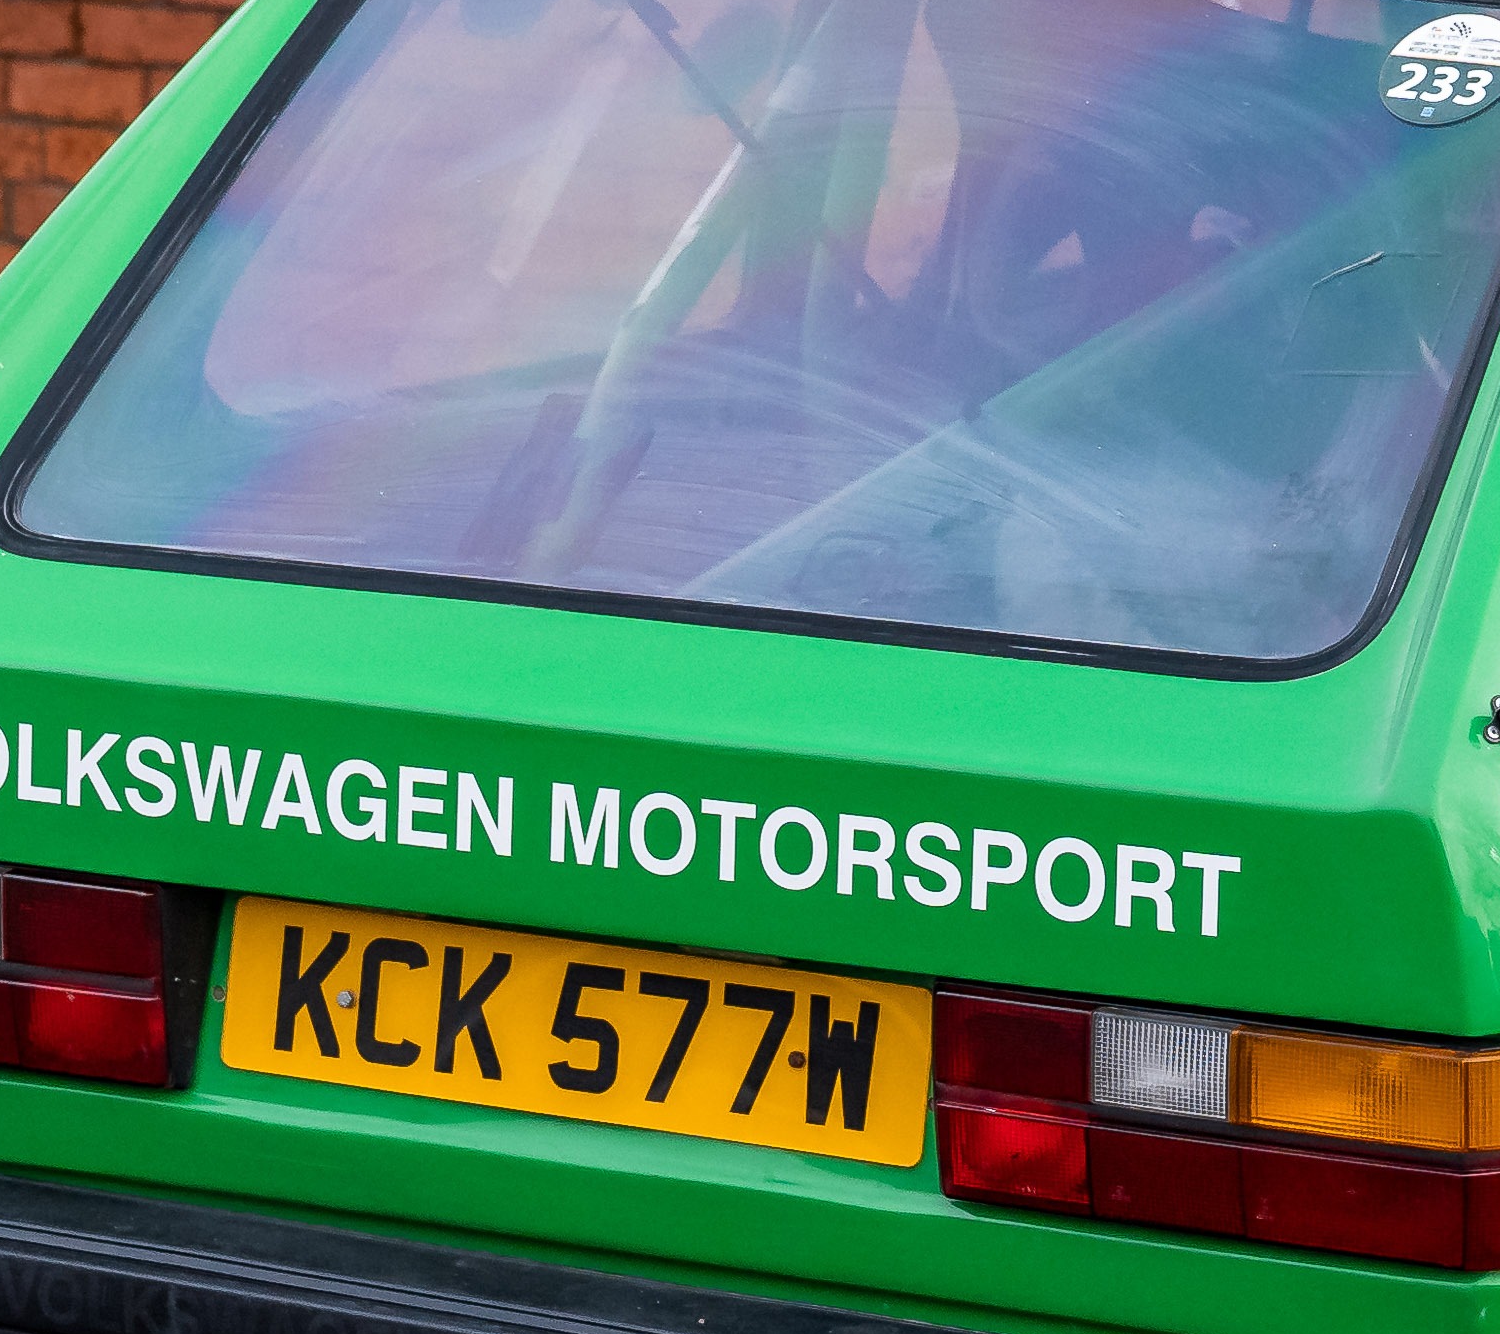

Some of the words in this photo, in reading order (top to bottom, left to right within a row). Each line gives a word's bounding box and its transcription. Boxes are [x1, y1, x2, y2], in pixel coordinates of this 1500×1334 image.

[1386, 62, 1494, 106] 233
[550, 783, 1240, 936] MOTORSPORT
[274, 926, 512, 1080] KCK
[548, 962, 880, 1131] 577W
